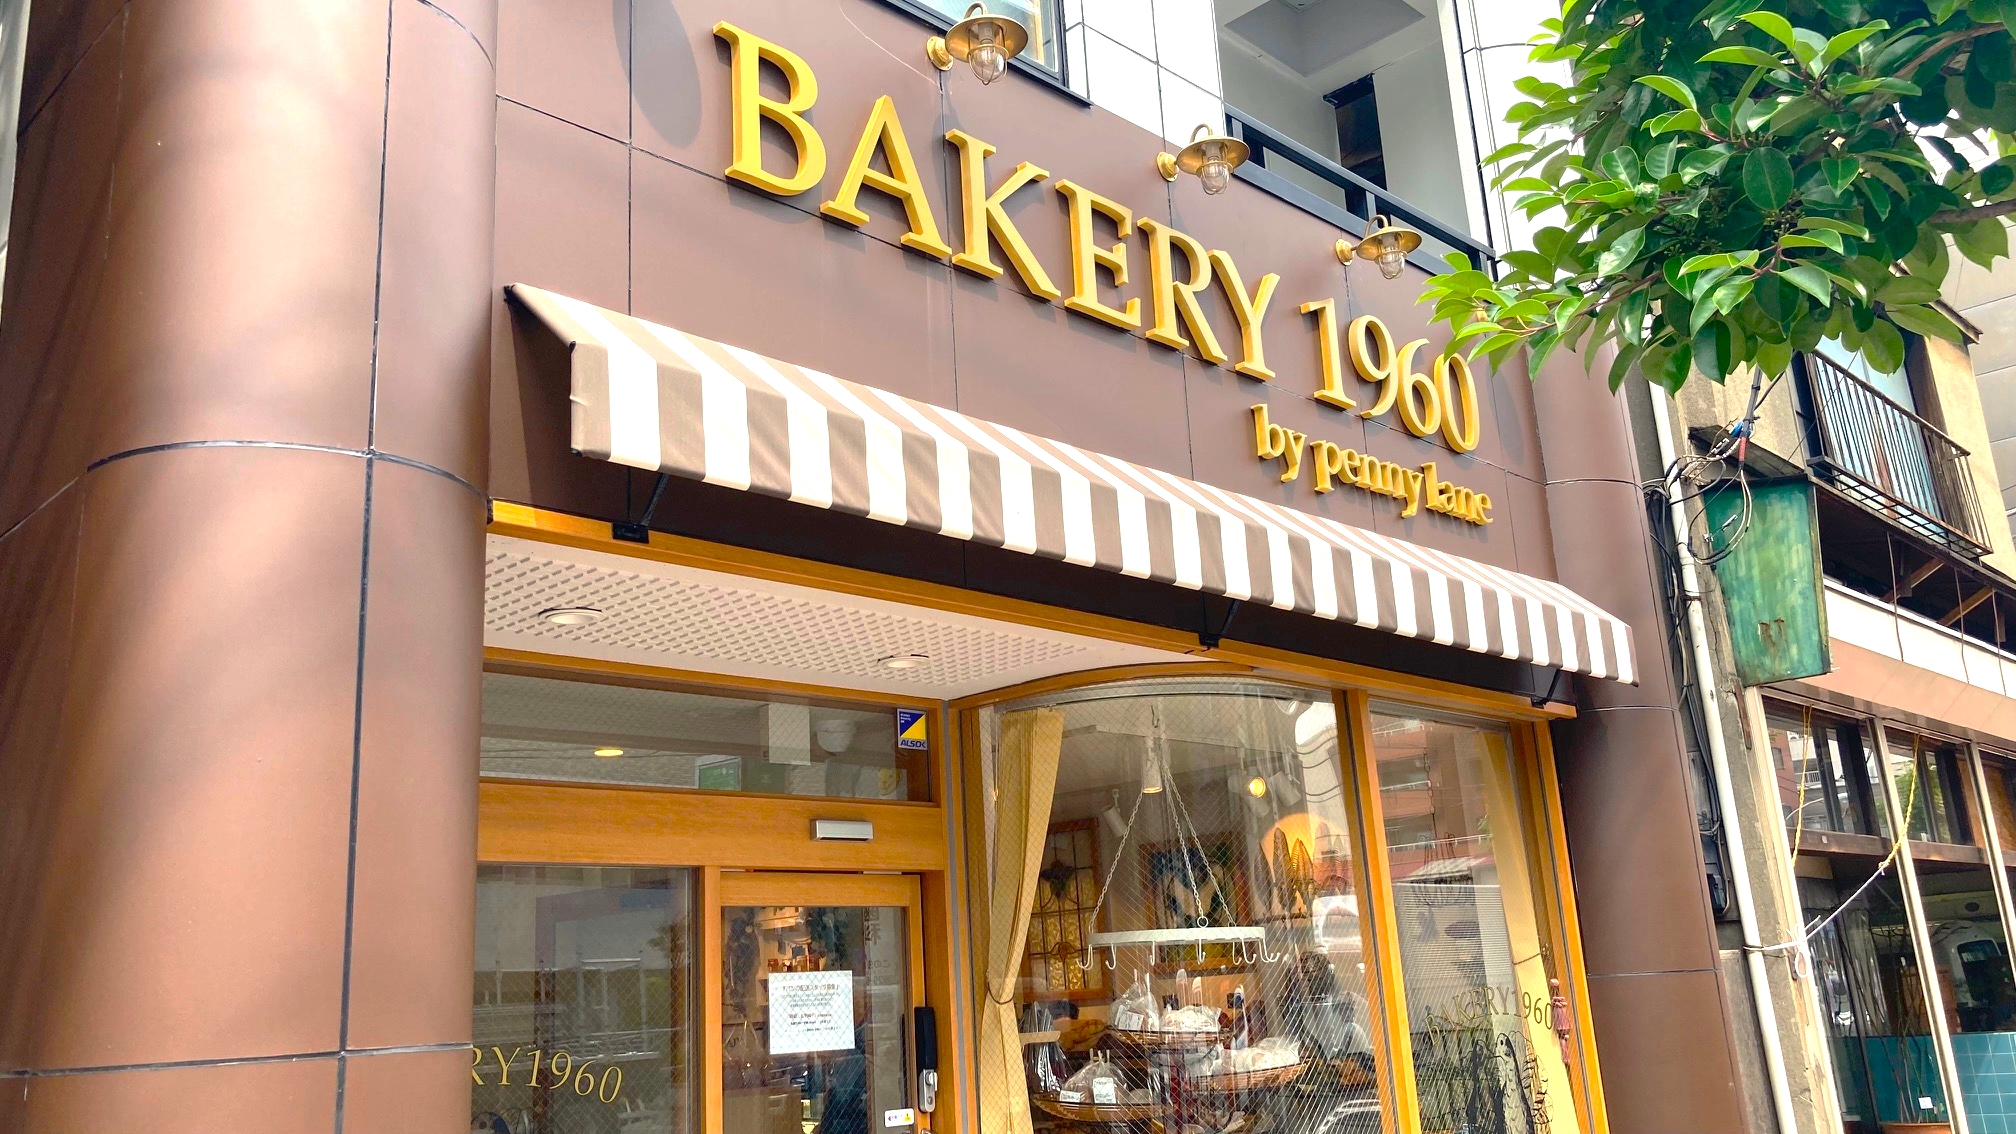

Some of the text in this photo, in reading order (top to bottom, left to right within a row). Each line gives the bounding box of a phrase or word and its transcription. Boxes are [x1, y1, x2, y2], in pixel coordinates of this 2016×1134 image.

[712, 20, 1480, 454] BAKERY 1960
[1250, 403, 1307, 483] by
[901, 739, 926, 748] ALSOK
